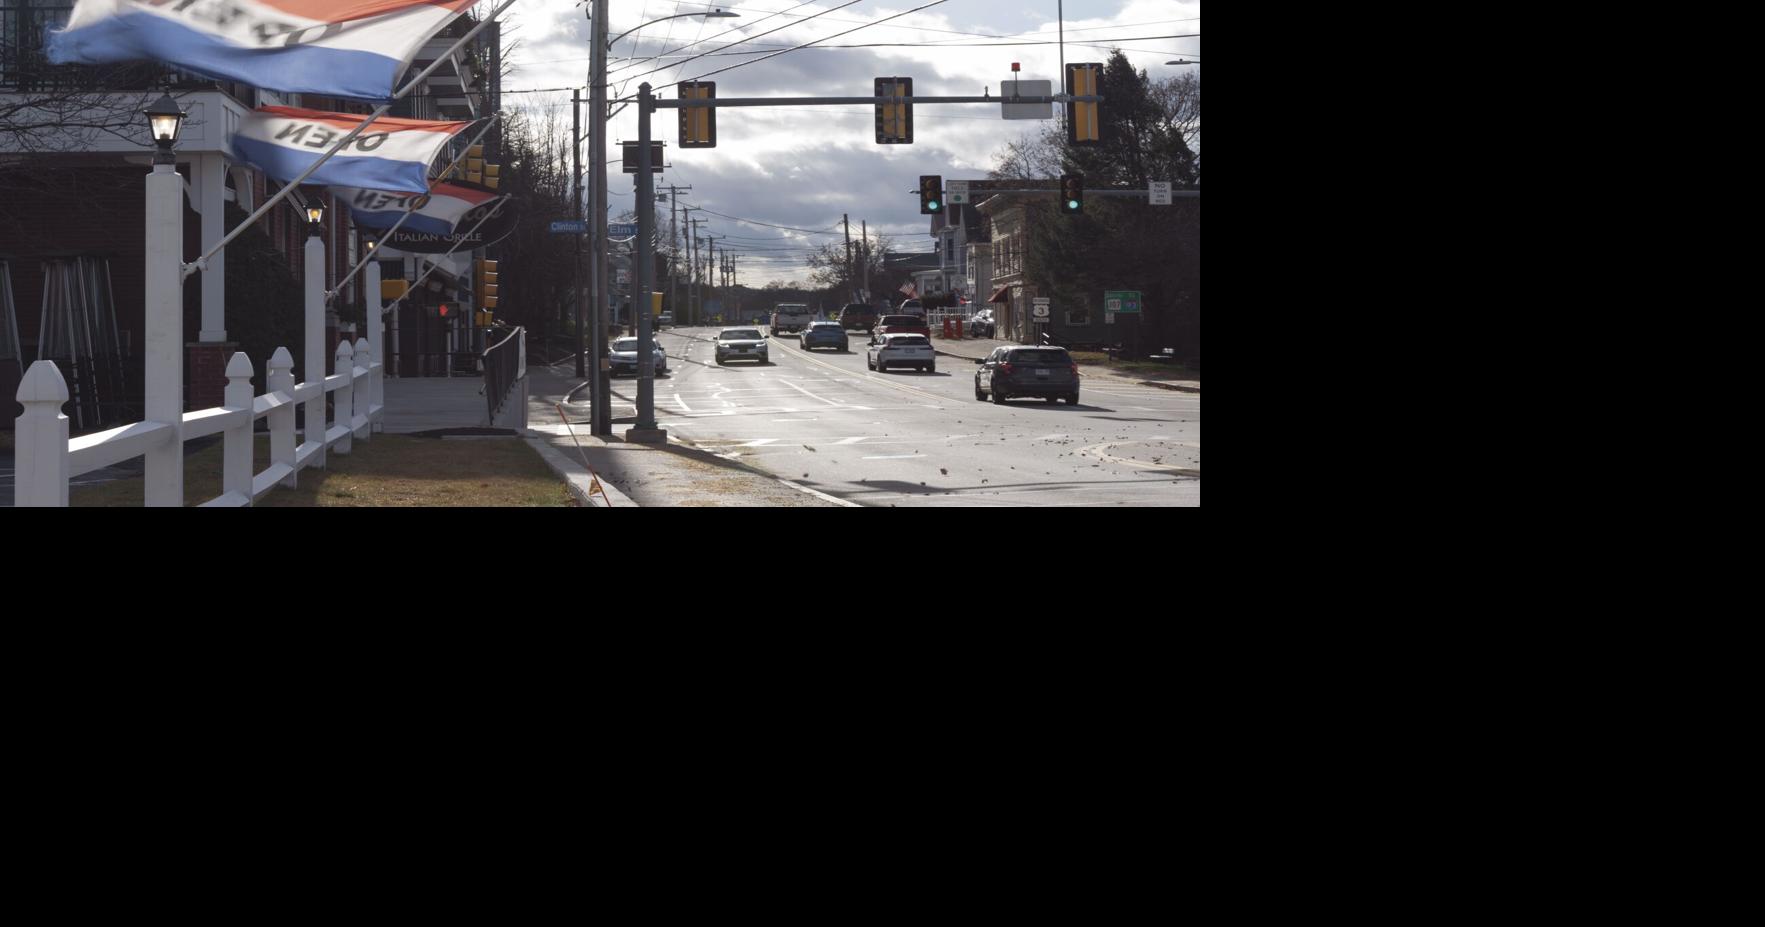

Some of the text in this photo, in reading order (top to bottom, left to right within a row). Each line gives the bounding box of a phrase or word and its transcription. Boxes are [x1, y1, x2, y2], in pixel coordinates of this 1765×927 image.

[551, 221, 578, 233] Clinton
[609, 225, 632, 234] Elm
[1038, 306, 1045, 315] 3
